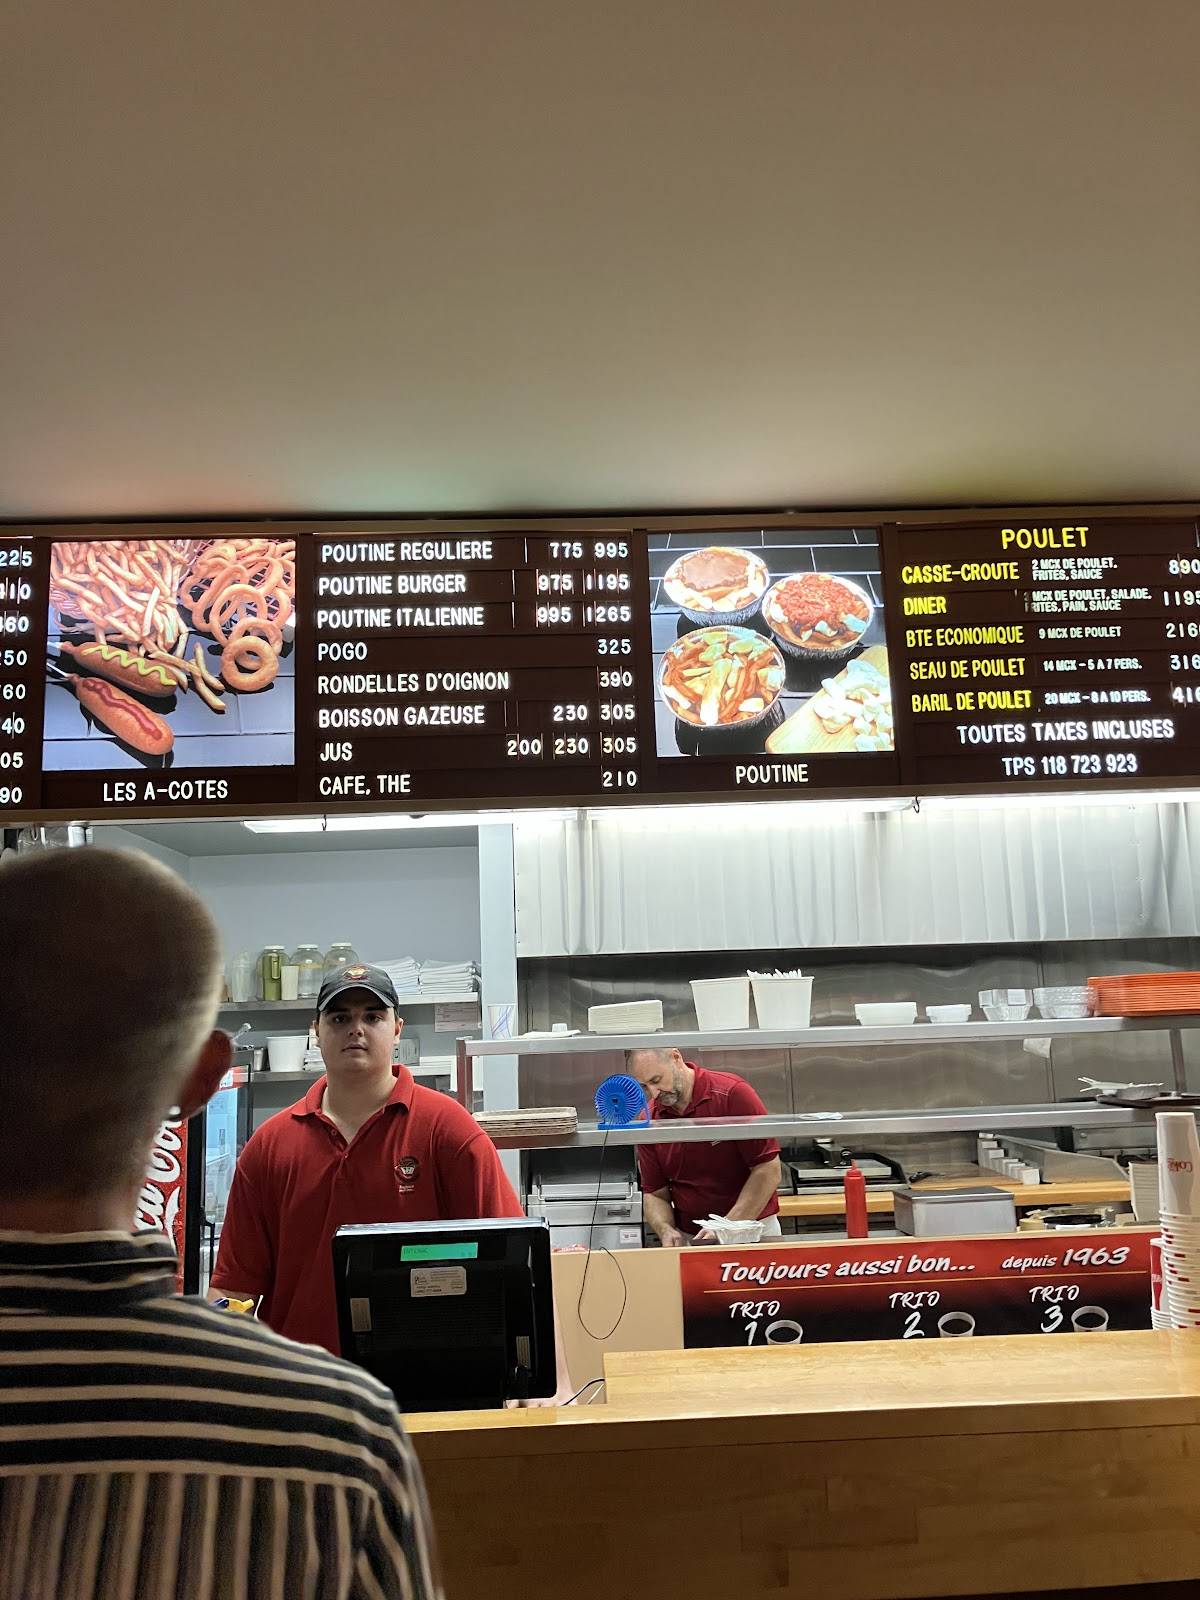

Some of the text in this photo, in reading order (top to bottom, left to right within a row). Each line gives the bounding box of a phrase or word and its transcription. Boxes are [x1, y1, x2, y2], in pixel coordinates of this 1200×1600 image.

[1002, 527, 1088, 549] POULET
[322, 541, 628, 562] POUTINE REGULIERE 775 995
[902, 562, 1019, 584] CASSE-CROUTE
[1032, 560, 1039, 569] 2
[1041, 559, 1061, 569] MCX
[1062, 558, 1076, 569] DE
[1070, 569, 1103, 580] SAUCE
[319, 573, 629, 595] POUTINE BURGER 975 1195
[904, 596, 946, 615] DINER
[1032, 590, 1053, 601] MCX
[1054, 590, 1068, 600] DE
[318, 606, 630, 628] POUTINE ITALIENNE 995 1265
[906, 626, 1024, 647] BTE ECONOMIQUE
[1039, 626, 1121, 639] 9 MCX DE POULET
[319, 639, 631, 661] POGO 325
[910, 658, 1025, 679] SEAU DE POULET
[318, 671, 633, 694] RONDELLES D'OIGNON 390
[912, 690, 1031, 712] BARIL DE POULET
[319, 704, 635, 728] BOISSON GAZEUSE 230 305
[957, 719, 1174, 743] TOUTES TAXES INCLUSES
[320, 738, 636, 761] JUS 200 230 305
[736, 764, 808, 783] POUTINE
[1002, 754, 1137, 775] TPS 118 723 923
[104, 780, 227, 801] LES A-COTES
[320, 771, 637, 795] CAFE, THE 210
[721, 1255, 975, 1285] Toujours aussi bon...
[1002, 1247, 1130, 1273] depuis 1963
[889, 1291, 940, 1309] TRIO
[1029, 1285, 1080, 1303] TRIO
[729, 1301, 780, 1318] TRIO
[1041, 1305, 1064, 1333] 3
[745, 1322, 758, 1346] 1
[903, 1312, 925, 1338] 2
